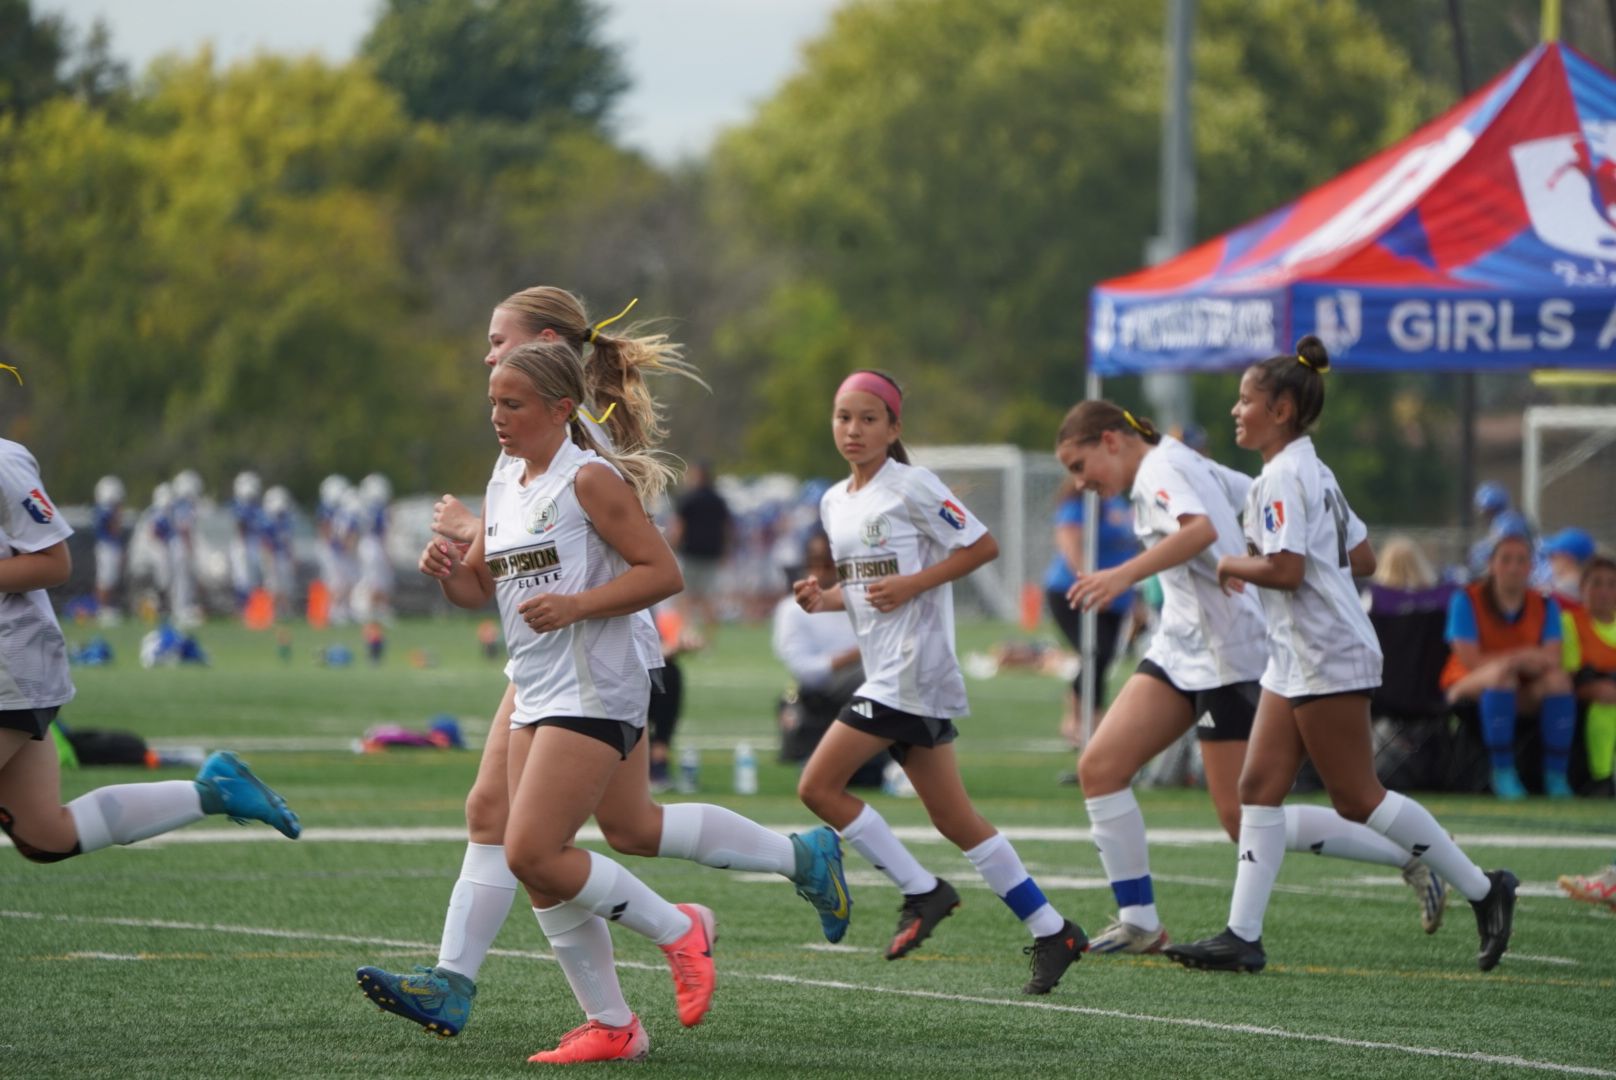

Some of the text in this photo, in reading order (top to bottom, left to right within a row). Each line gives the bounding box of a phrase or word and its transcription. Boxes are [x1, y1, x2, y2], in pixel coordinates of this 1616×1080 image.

[1388, 298, 1576, 352] GIRLS
[508, 546, 561, 574] FUSION
[855, 558, 899, 579] FUSION
[518, 571, 562, 589] ELITE
